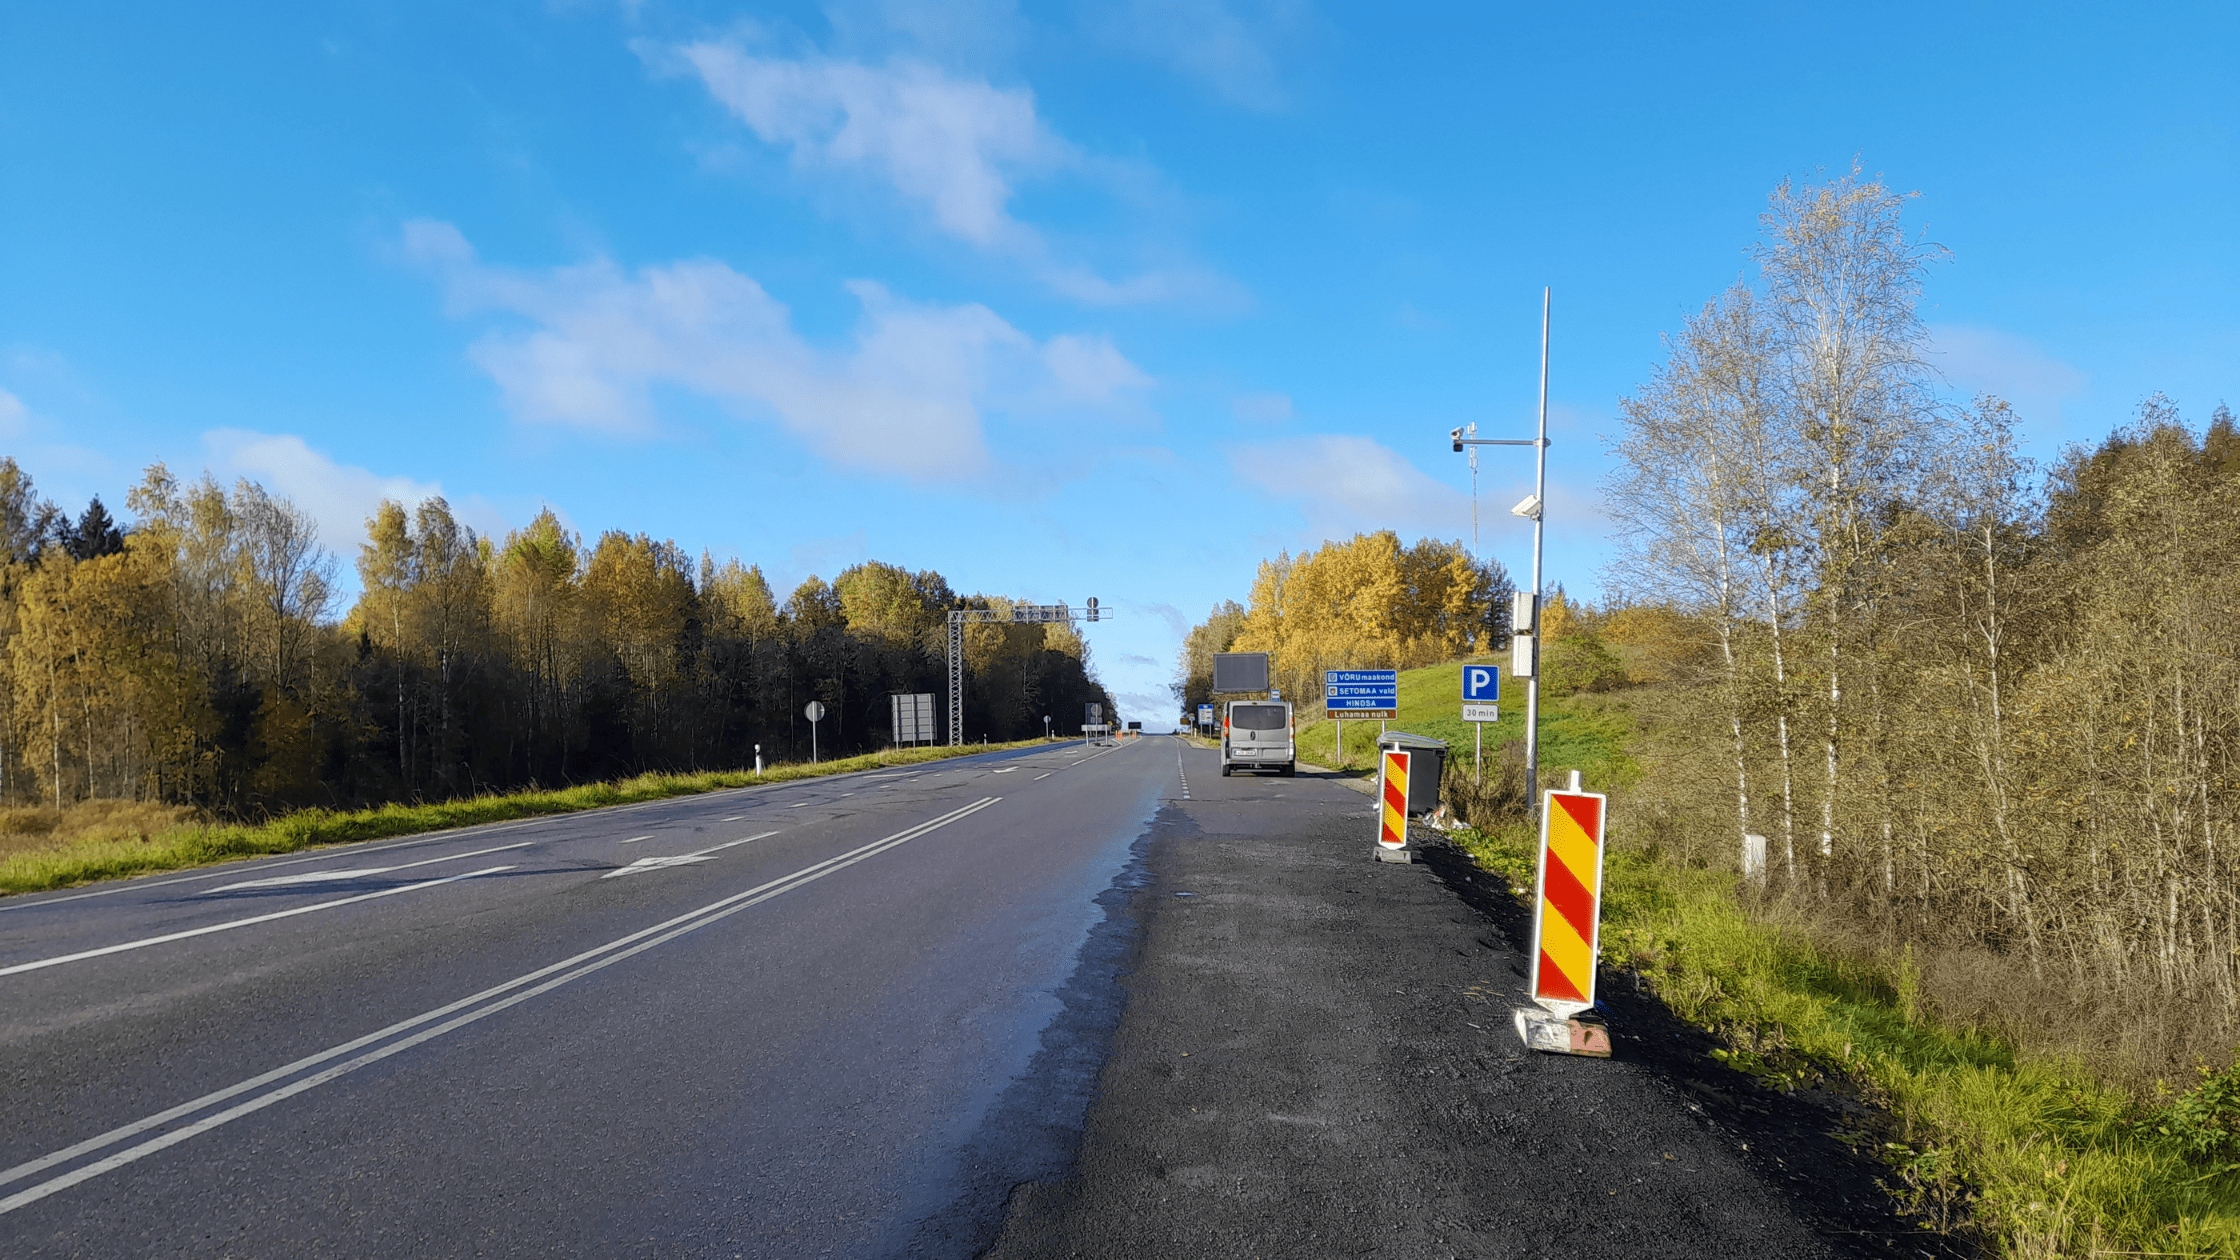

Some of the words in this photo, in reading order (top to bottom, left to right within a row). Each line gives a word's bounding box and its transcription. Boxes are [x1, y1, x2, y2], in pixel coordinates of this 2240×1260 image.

[1339, 673, 1361, 681] VÕRU
[1361, 673, 1395, 681] maakond
[1471, 668, 1490, 696] P
[1339, 687, 1377, 695] SETOMAA
[1379, 687, 1395, 695] vald
[1466, 709, 1477, 717] 30
[1478, 709, 1495, 717] min
